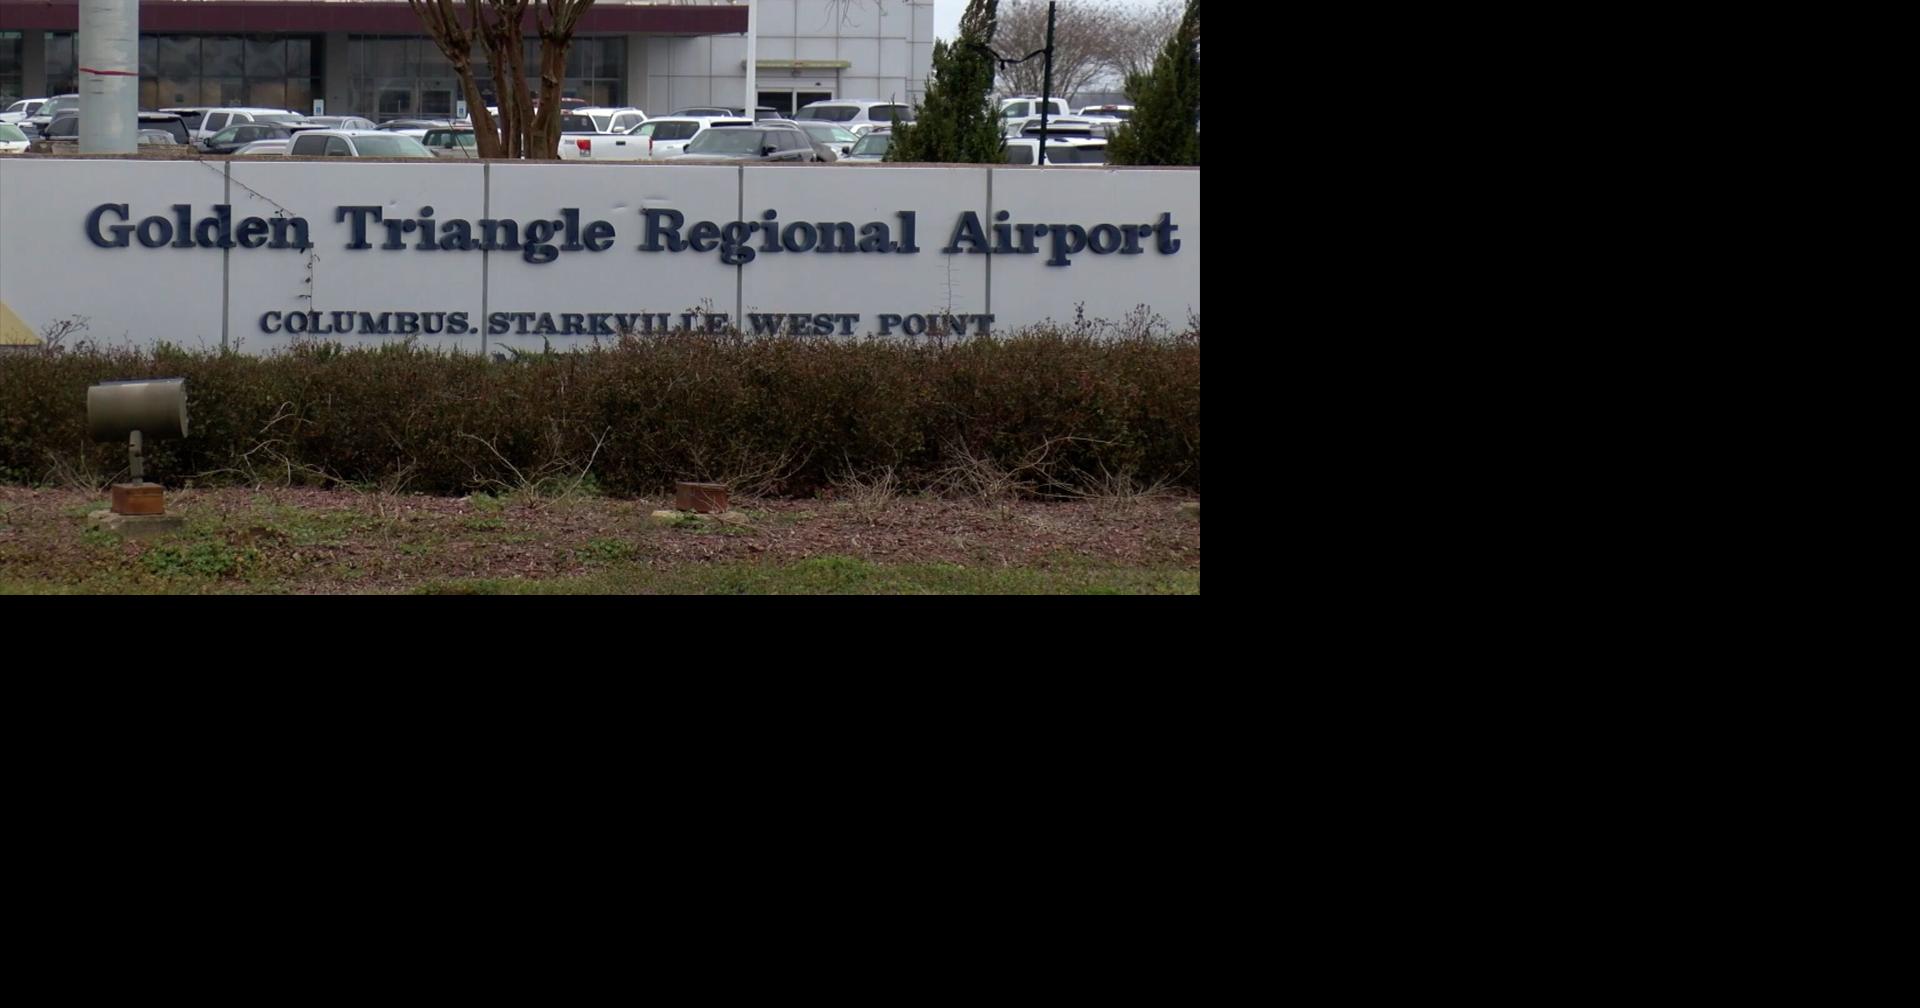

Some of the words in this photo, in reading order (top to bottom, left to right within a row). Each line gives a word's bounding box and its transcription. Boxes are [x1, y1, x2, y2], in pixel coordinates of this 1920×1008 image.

[83, 203, 313, 250] Golden
[336, 205, 616, 264] Triangle
[639, 208, 920, 265] Regional
[943, 210, 1182, 267] Airport
[747, 312, 860, 336] WEST
[877, 312, 995, 336] POINT
